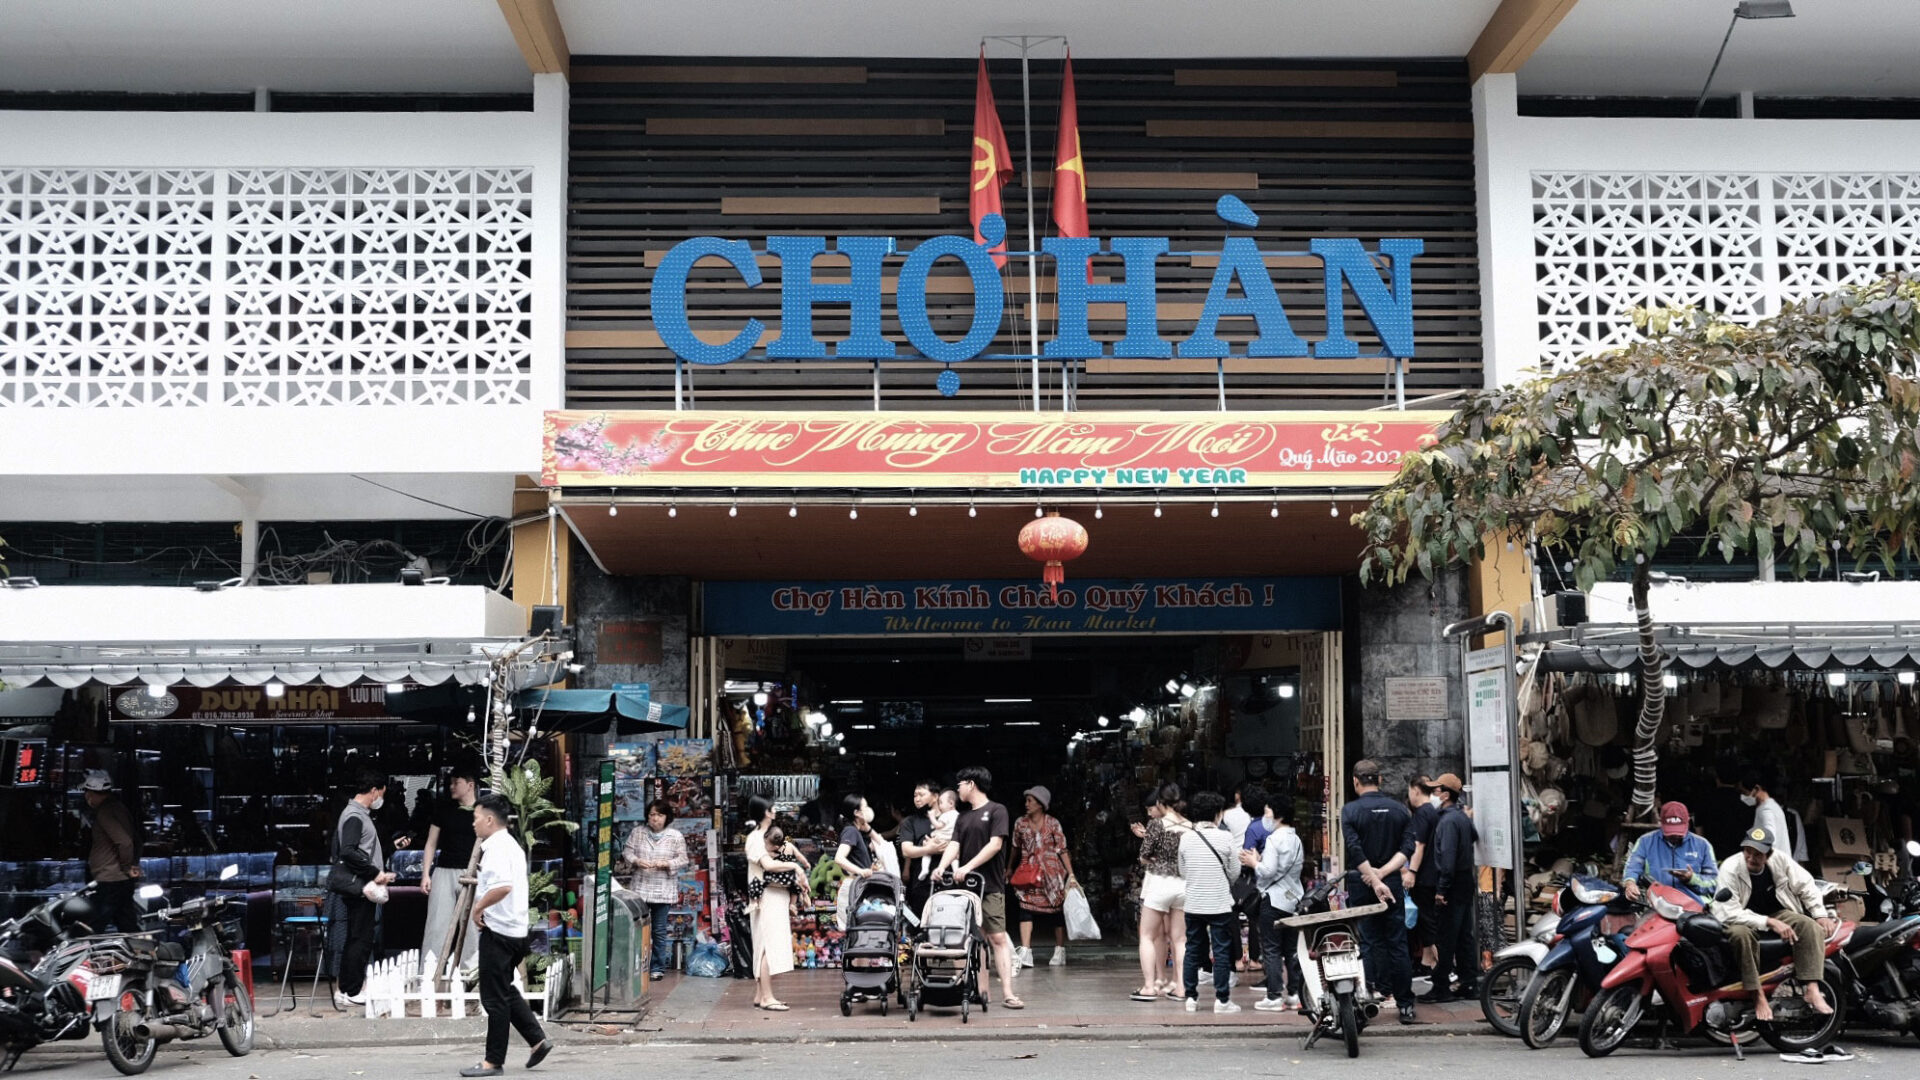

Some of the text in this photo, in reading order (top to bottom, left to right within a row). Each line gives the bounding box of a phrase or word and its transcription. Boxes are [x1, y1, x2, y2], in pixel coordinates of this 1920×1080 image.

[650, 194, 1424, 397] CHỢ HÀN
[664, 418, 802, 466] Chúc
[762, 418, 981, 468] Mừng
[987, 421, 1136, 456] Năm
[1080, 421, 1277, 467] Mới
[1279, 444, 1403, 470] Quý Mão 202
[1020, 468, 1247, 485] HAPPY NEW YEAR
[772, 582, 1274, 616] Chợ Hàn Kính Chào Quý Khách !
[991, 617, 1010, 630] to
[1022, 615, 1071, 630] Han
[1082, 614, 1158, 630] Market
[199, 690, 262, 711] DUY
